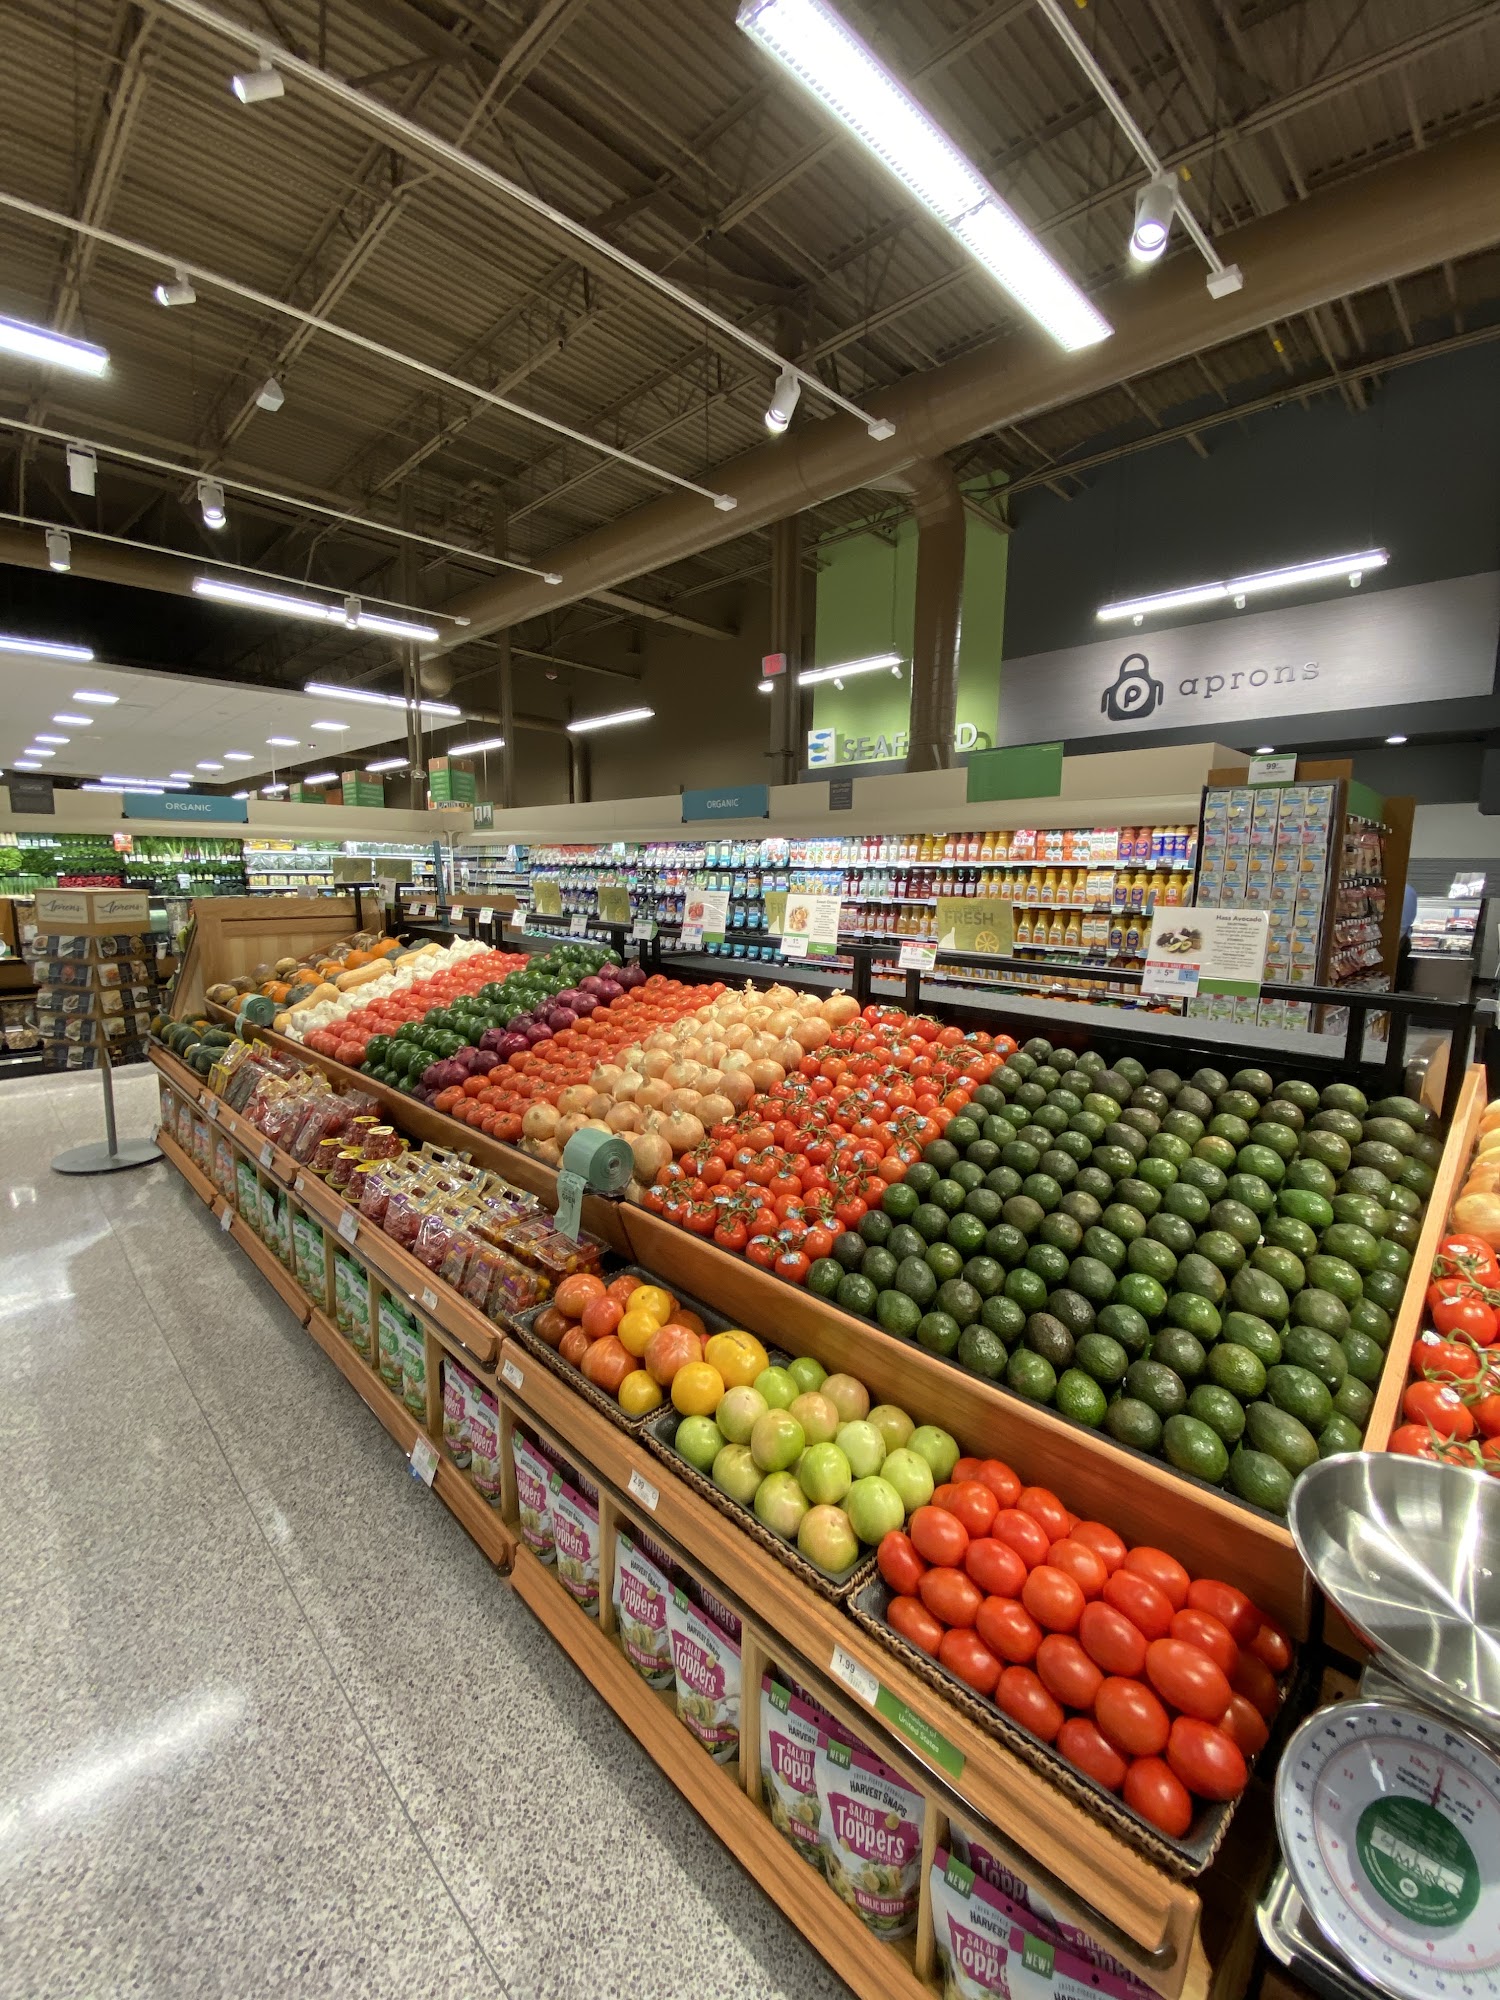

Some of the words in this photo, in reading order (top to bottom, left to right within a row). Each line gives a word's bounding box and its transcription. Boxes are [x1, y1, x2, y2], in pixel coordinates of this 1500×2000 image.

[1178, 660, 1321, 699] aprons
[842, 722, 978, 762] SEAFD
[165, 802, 212, 812] ORGANIC
[706, 798, 739, 809] ORGANIC
[944, 911, 994, 926] FRESH
[1232, 915, 1262, 923] Avocado
[553, 1518, 584, 1556] Toppers
[621, 1576, 659, 1622] Toppers
[674, 1640, 717, 1694] Toppers
[838, 1654, 856, 1674] 1.99
[771, 1692, 787, 1712] NEW!
[787, 1723, 816, 1746] HARVEST
[898, 1713, 920, 1736] United
[919, 1731, 940, 1753] States
[776, 1742, 815, 1786] Topp
[786, 1742, 811, 1764] SALAD
[829, 1748, 849, 1767] NEW!
[849, 1779, 882, 1800] HARVEST
[881, 1791, 908, 1818] SNAPS
[848, 1802, 875, 1826] SALAD
[836, 1805, 905, 1860] Toppers
[947, 1871, 971, 1894] NEW!
[858, 1892, 880, 1911] GARLIC
[969, 1909, 1009, 1940] HARVEST
[954, 1930, 1009, 1985] Toppe
[966, 1933, 999, 1958] SALAD
[1025, 1950, 1051, 1972] NEW!
